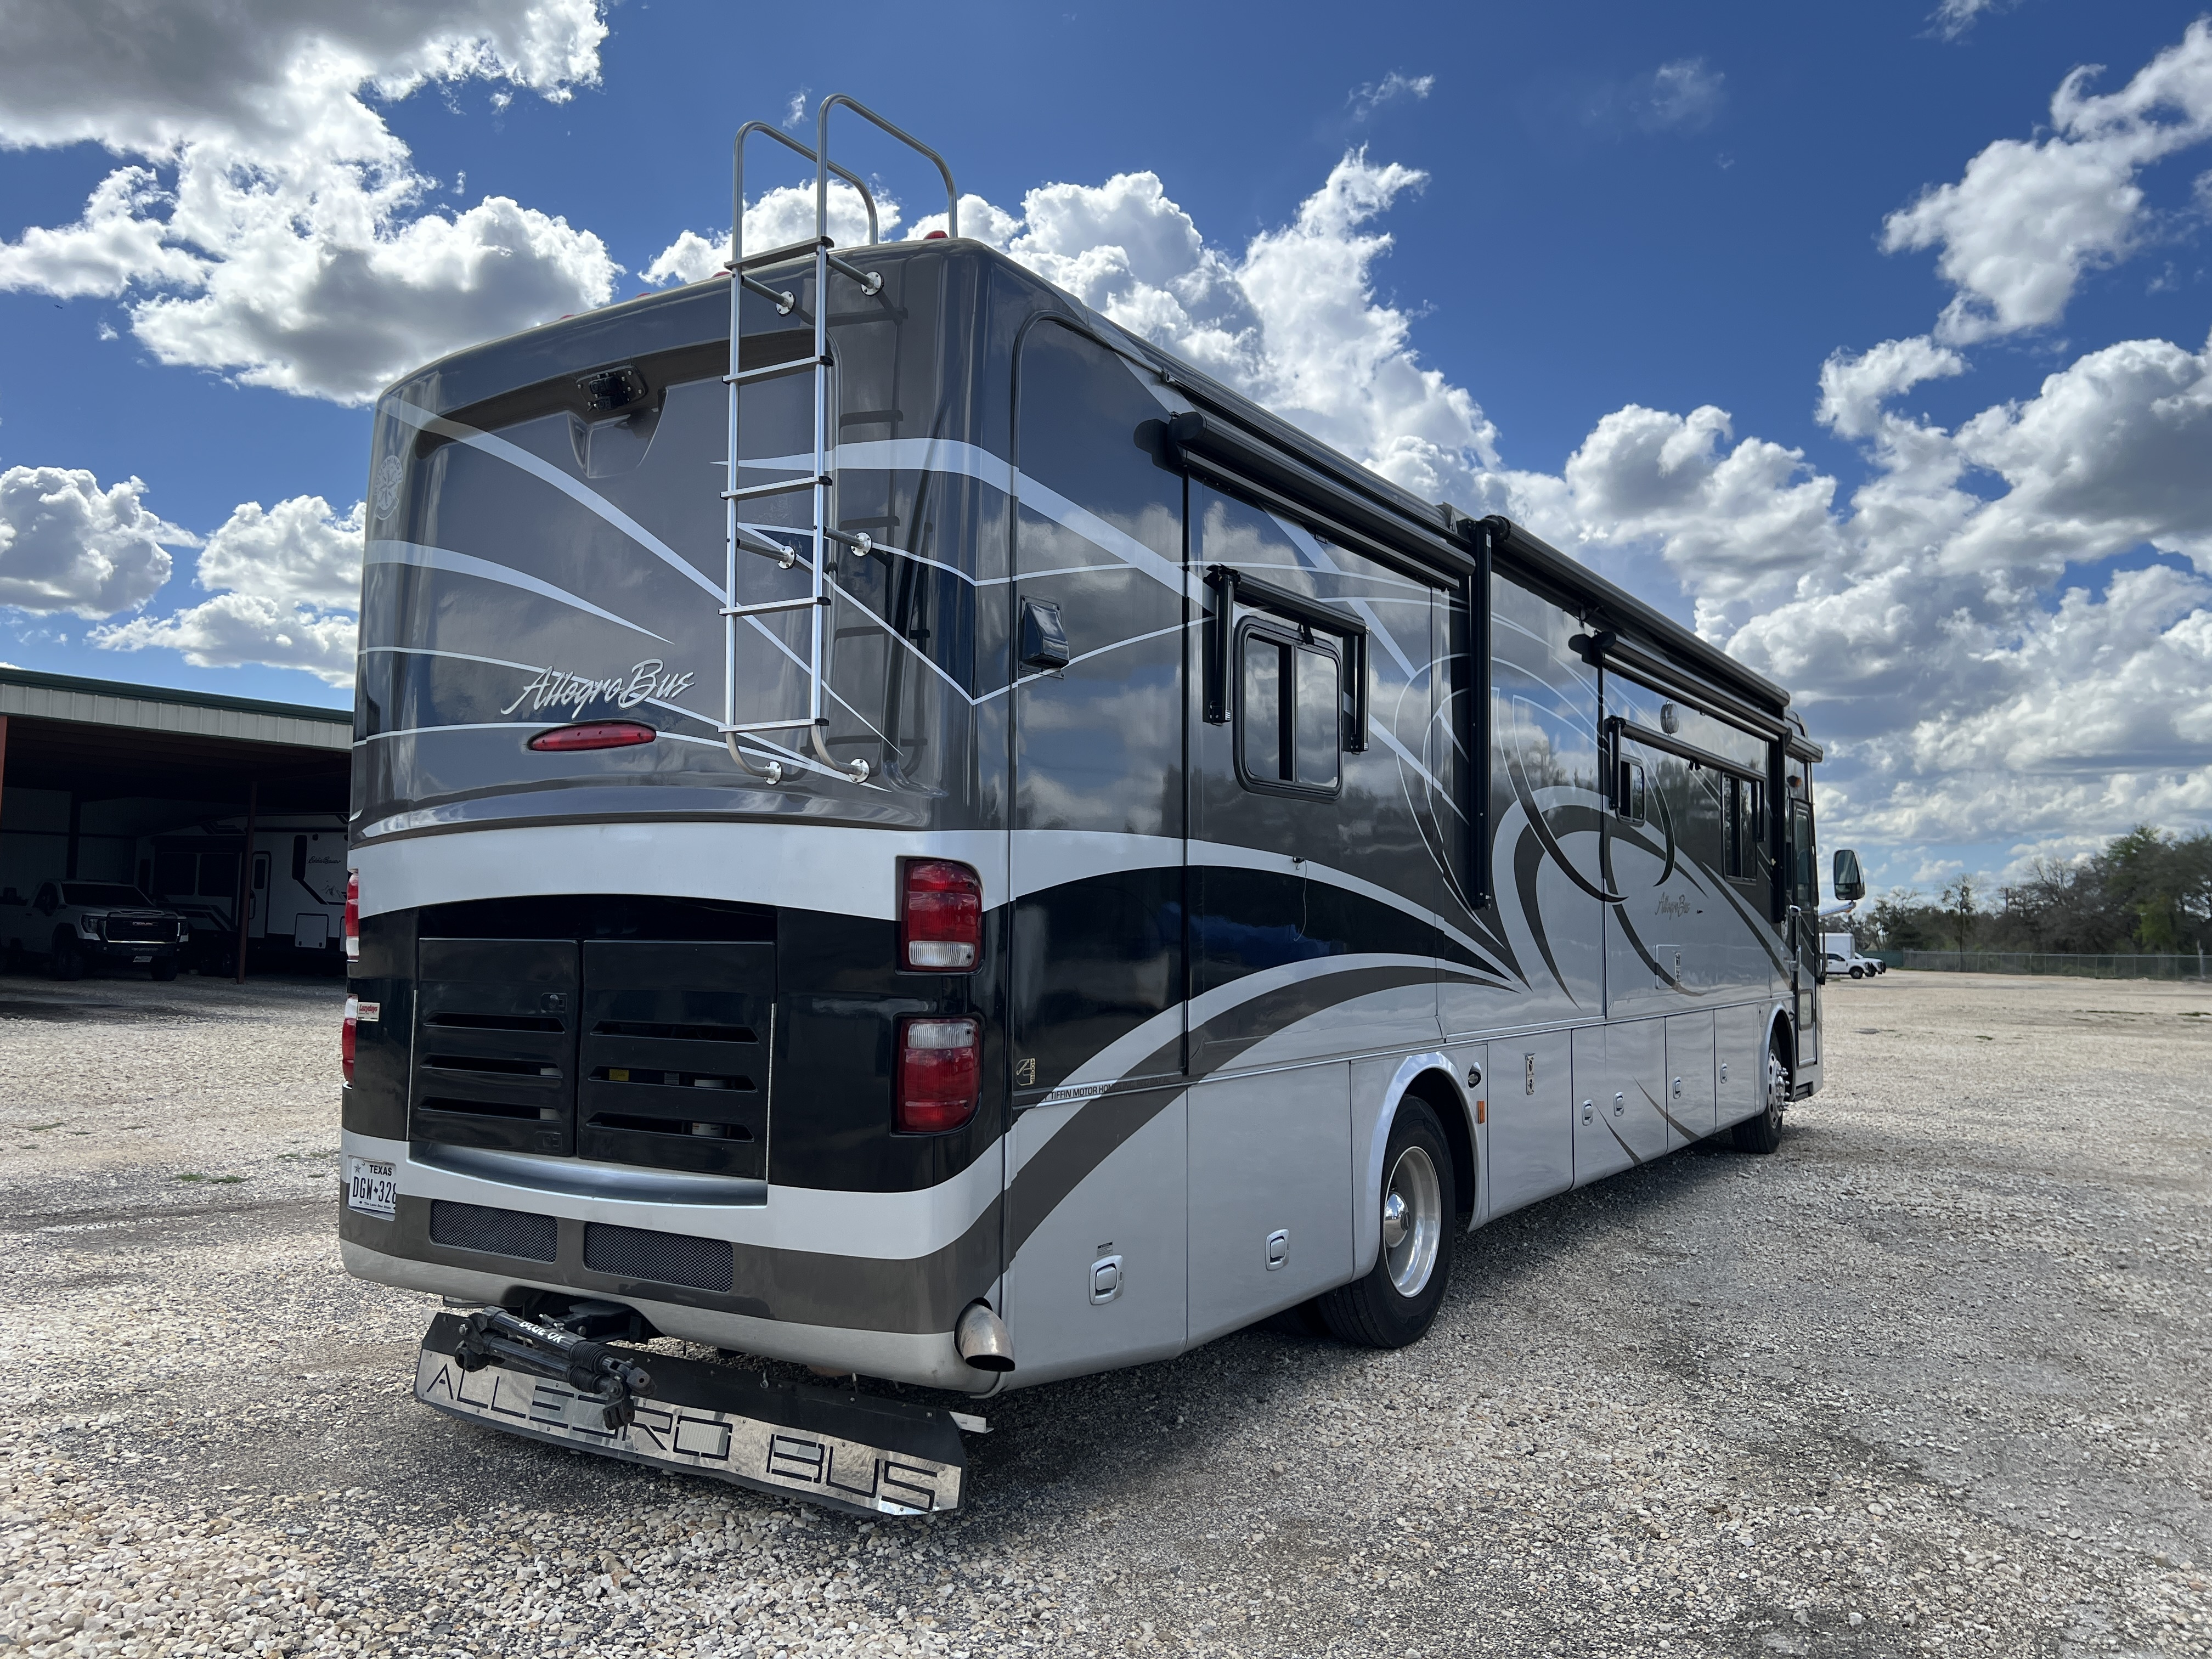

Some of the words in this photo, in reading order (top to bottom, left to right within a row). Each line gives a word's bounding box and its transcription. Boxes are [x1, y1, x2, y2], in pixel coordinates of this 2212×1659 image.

[500, 665, 624, 720] Allegro
[618, 658, 695, 710] Bus
[1051, 1089, 1071, 1100] TIFFIN
[1073, 1086, 1097, 1097] MOTOR
[369, 1164, 392, 1176] TEXAS
[352, 1176, 373, 1200] DGW
[766, 1433, 936, 1513] BUS
